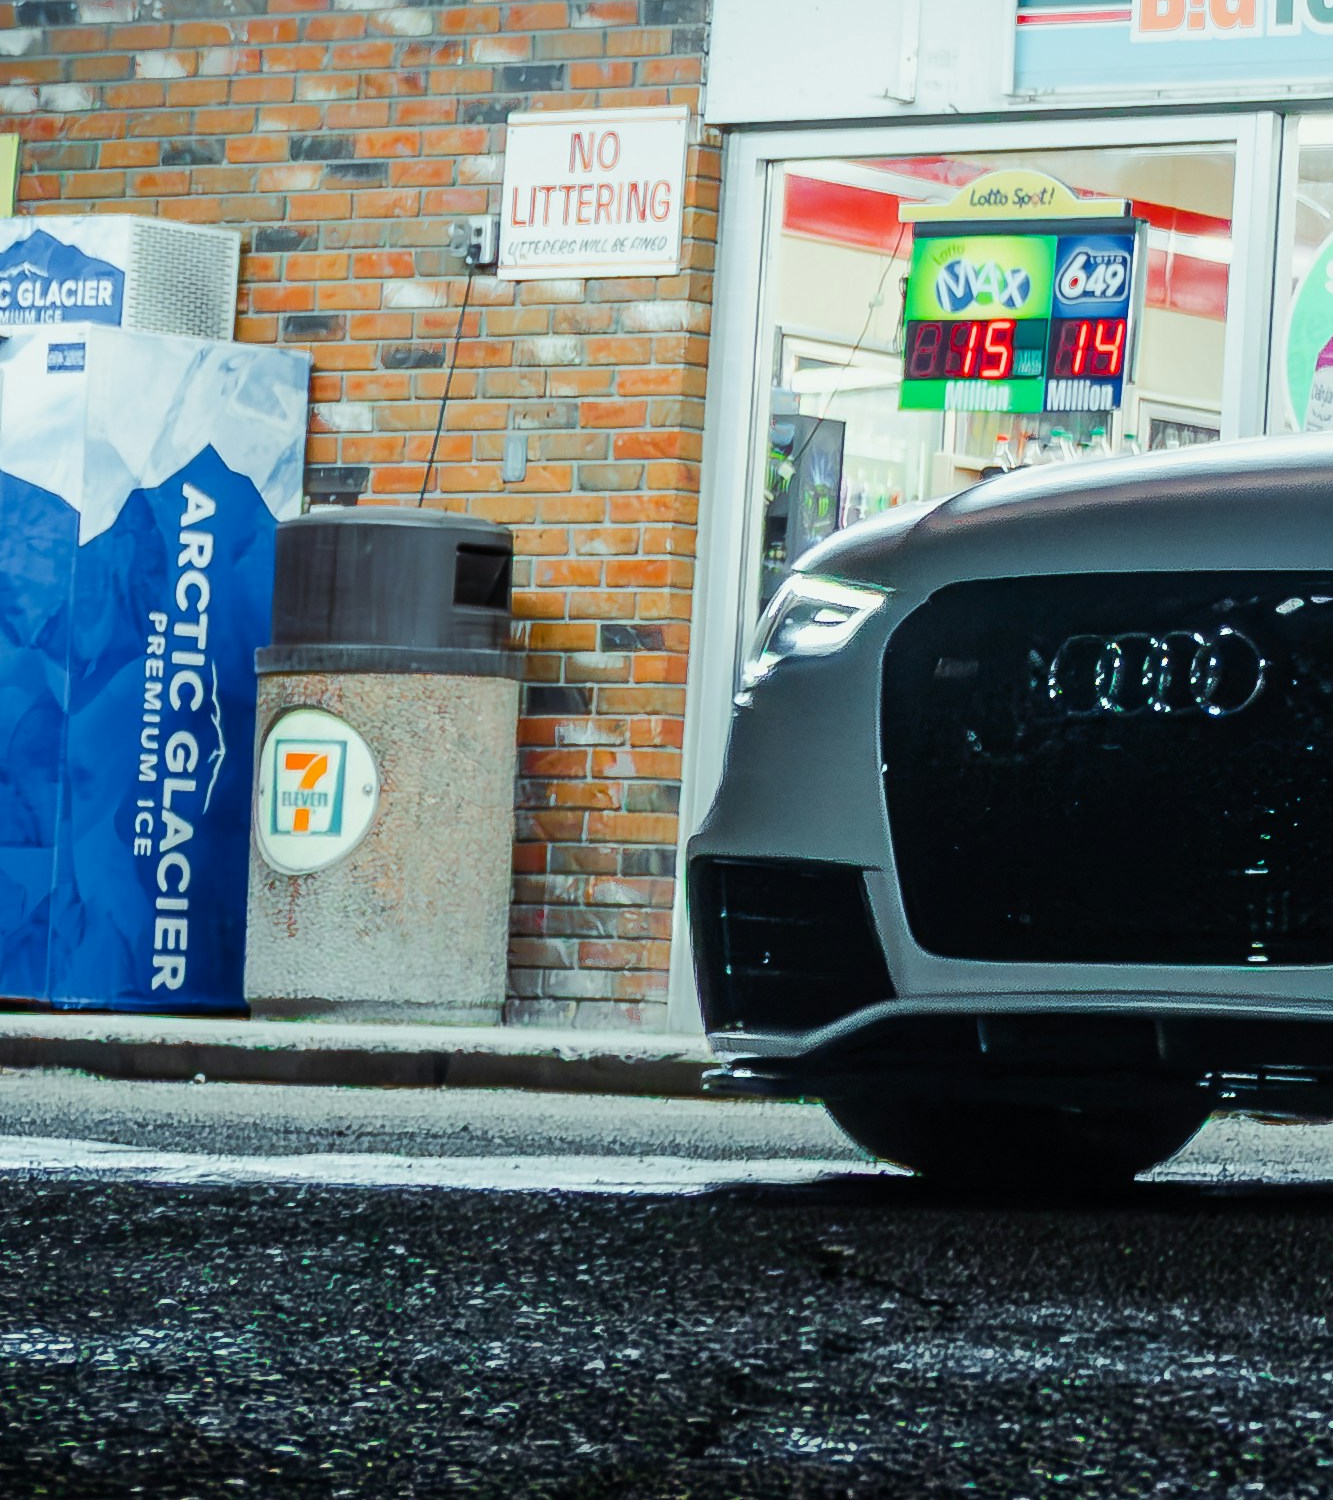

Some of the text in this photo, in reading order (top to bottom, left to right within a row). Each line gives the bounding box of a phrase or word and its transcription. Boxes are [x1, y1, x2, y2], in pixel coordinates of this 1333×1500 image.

[568, 130, 621, 174] NO
[511, 180, 672, 228] LITTERING
[969, 188, 1009, 208] Lotto
[17, 279, 113, 308] GLACIER
[963, 318, 1016, 379] 15
[1073, 318, 1126, 377] 14
[1047, 378, 1114, 412] Million
[134, 611, 169, 857] PREMIUM ICE
[151, 482, 217, 991] ARCTIC GLACIER
[285, 751, 329, 833] 7
